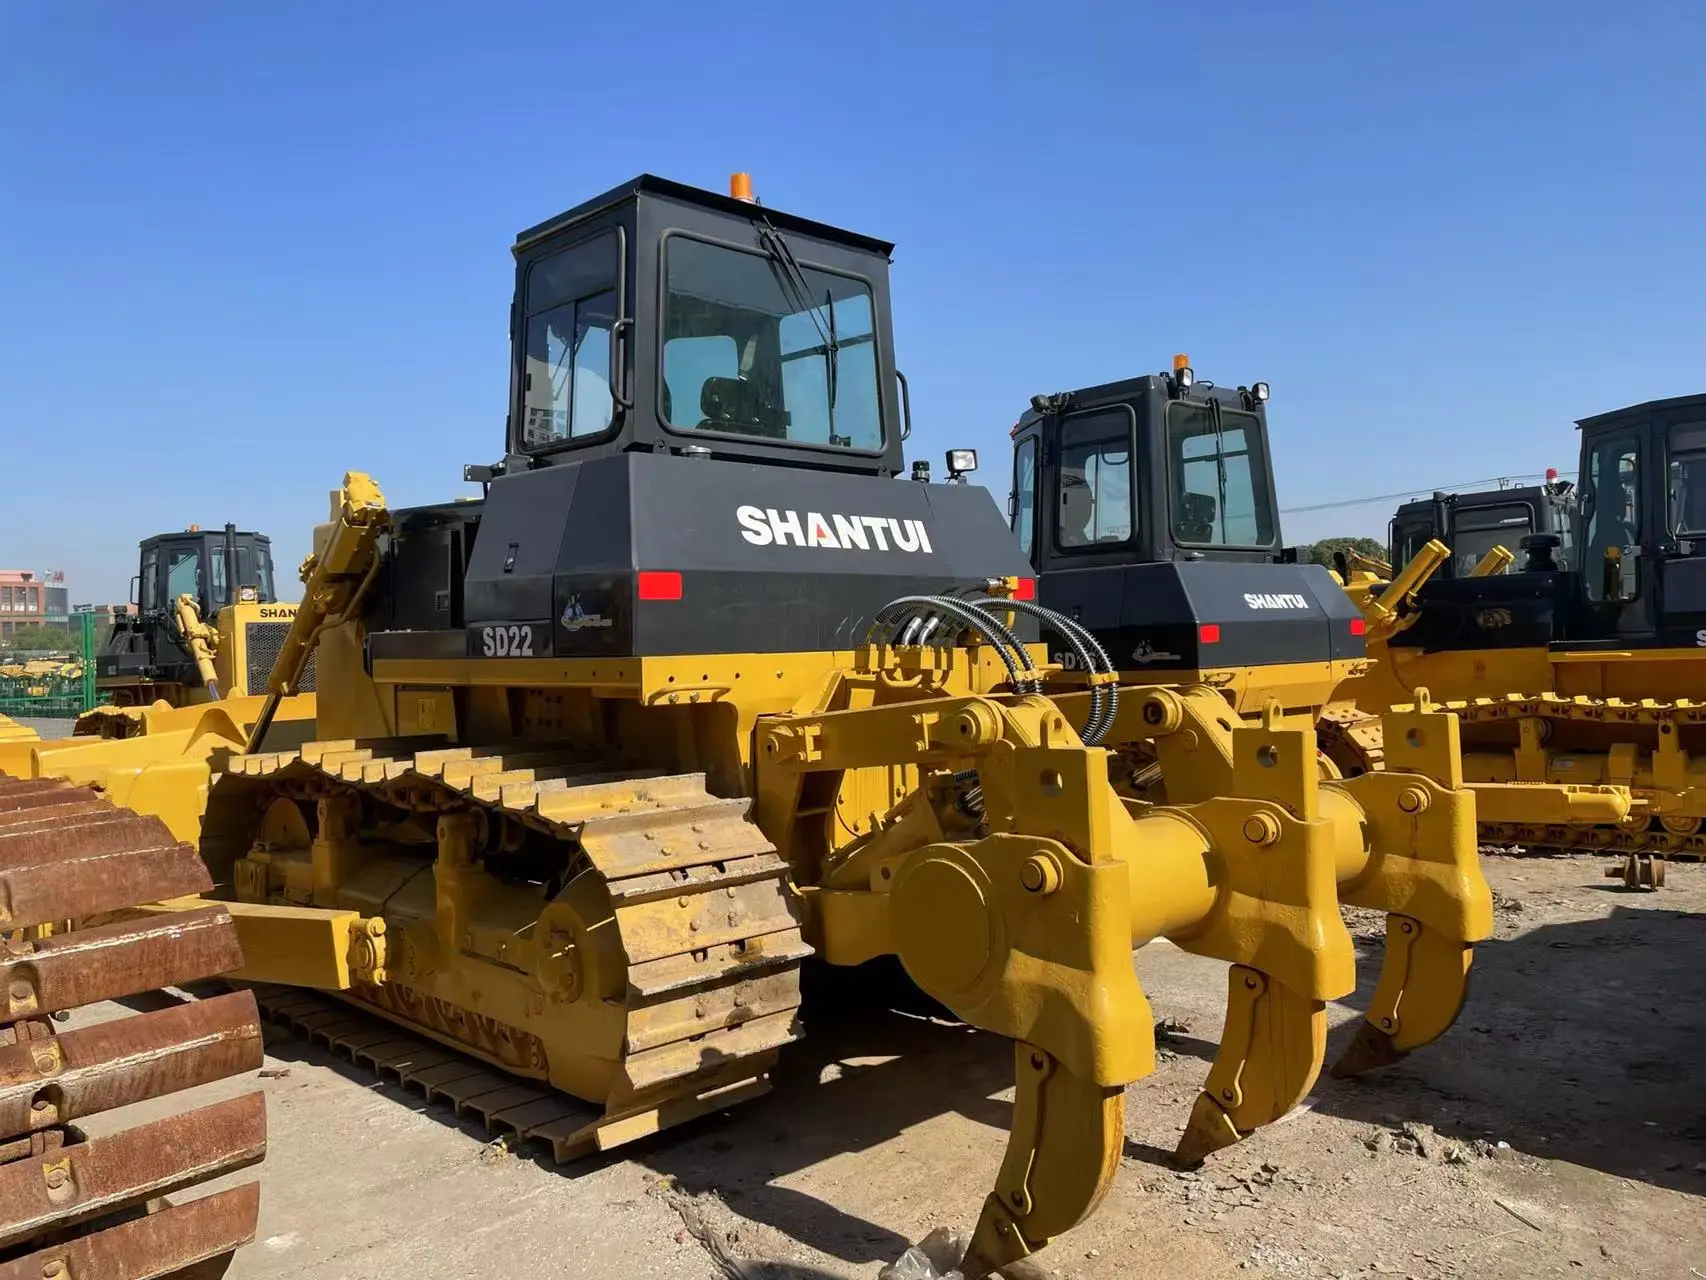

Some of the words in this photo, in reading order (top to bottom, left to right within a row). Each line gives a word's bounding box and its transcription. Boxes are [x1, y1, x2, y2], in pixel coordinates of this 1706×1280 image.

[736, 505, 933, 554] SHANTUI
[1243, 593, 1309, 609] SHANTUI
[483, 625, 533, 656] SD22
